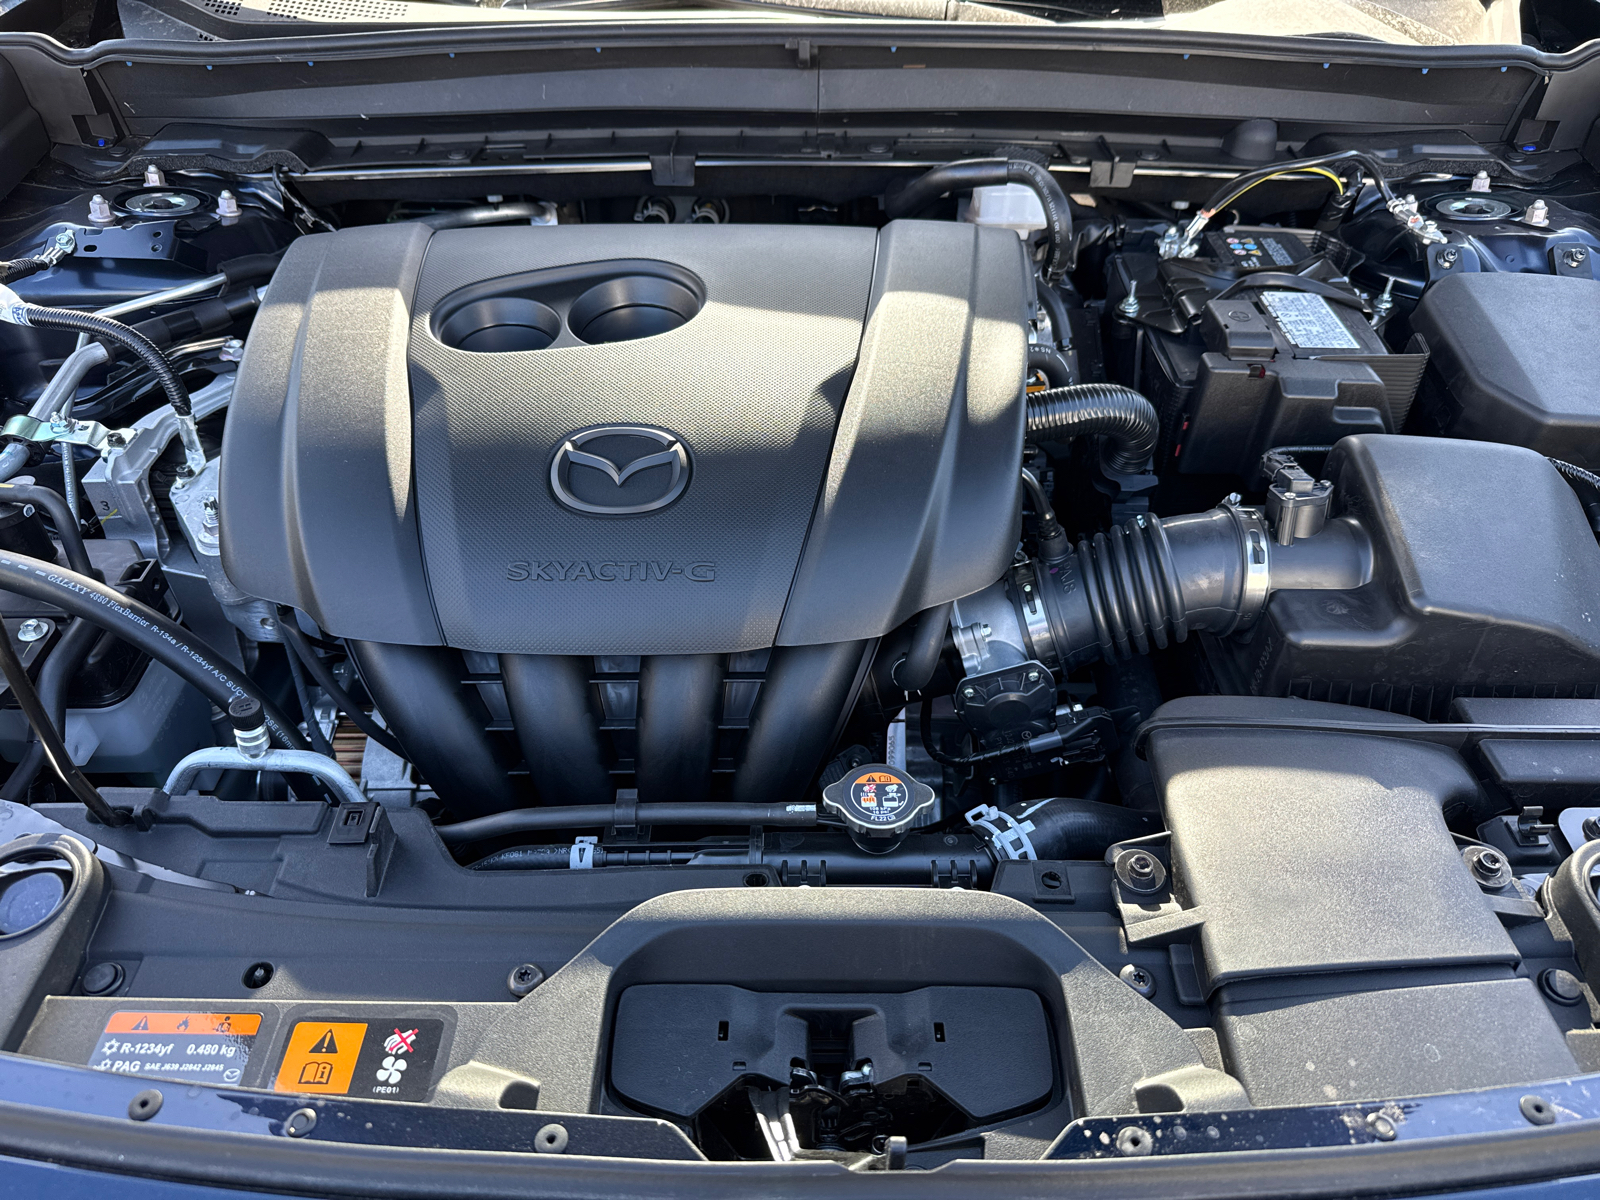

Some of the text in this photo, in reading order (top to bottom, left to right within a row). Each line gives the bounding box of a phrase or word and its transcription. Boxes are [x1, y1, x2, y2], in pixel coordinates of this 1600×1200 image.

[100, 500, 110, 511] 3
[507, 561, 716, 582] SKYACTIV-G
[47, 574, 91, 595] GALAXY
[107, 600, 150, 628] FlexBarrier
[150, 625, 177, 645] R-134a
[181, 645, 214, 670] R-1234yf
[211, 669, 227, 682] A/C
[263, 713, 279, 731] OSE
[120, 1043, 236, 1057] R-1234yf 0.480 kg
[112, 1060, 141, 1072] PAG
[144, 1063, 161, 1071] SAE
[161, 1063, 179, 1071] J639
[372, 1085, 400, 1094] (PE01)
